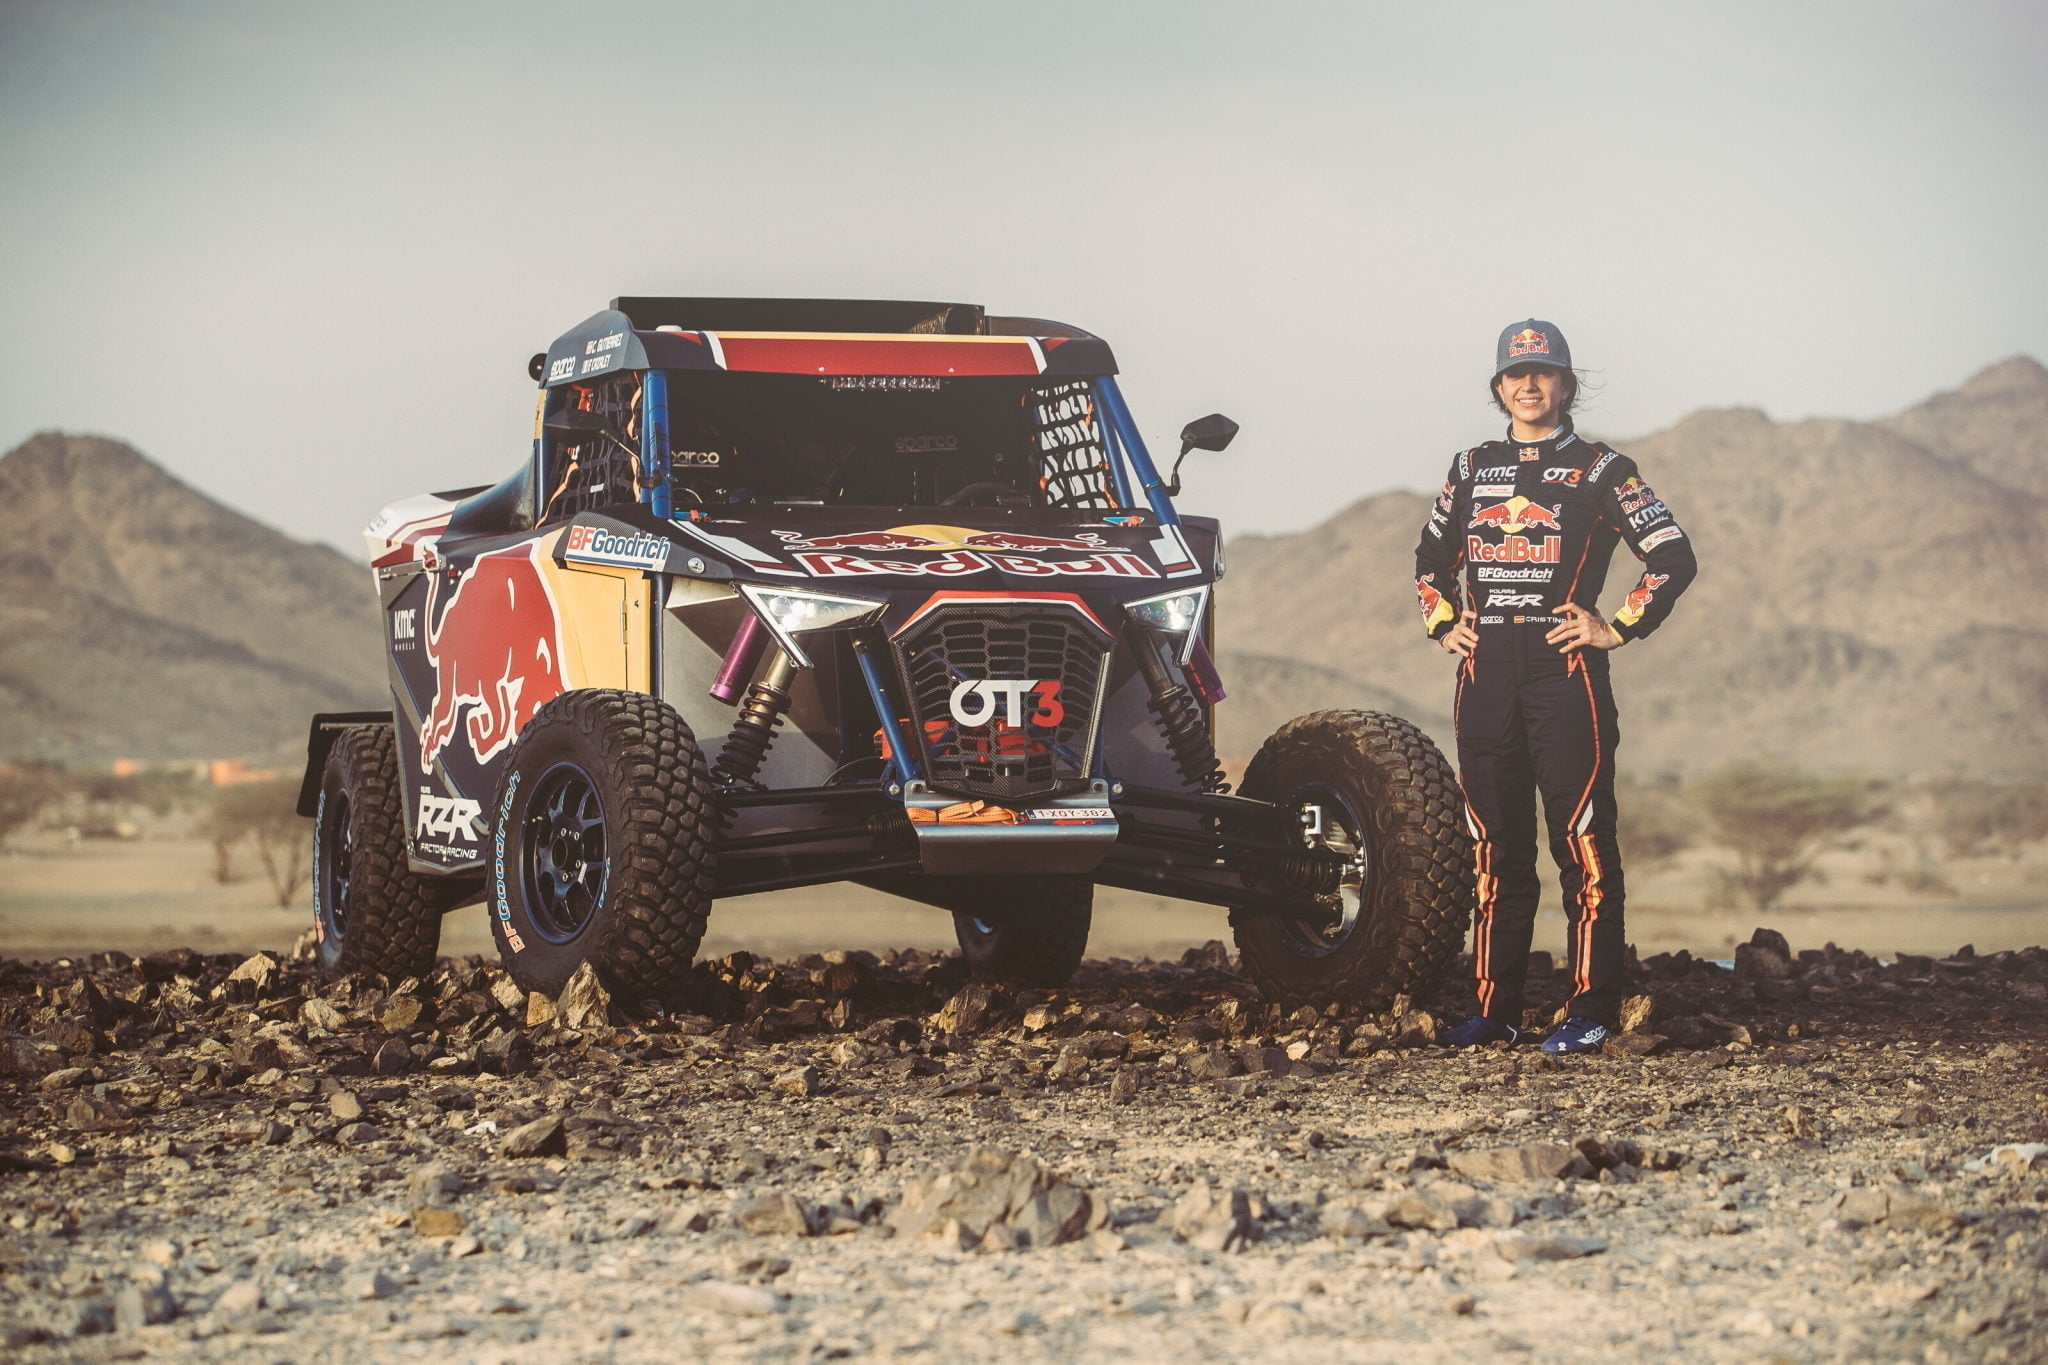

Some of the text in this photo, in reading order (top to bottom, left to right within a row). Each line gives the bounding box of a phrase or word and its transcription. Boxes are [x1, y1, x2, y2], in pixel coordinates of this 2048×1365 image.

[671, 450, 720, 465] arco
[567, 525, 671, 560] BFGoodrich
[1477, 567, 1553, 580] BFGoodrich
[1484, 594, 1544, 609] RZR
[394, 608, 415, 640] KMC
[416, 794, 482, 845] RZR
[446, 846, 478, 859] RACING
[496, 769, 526, 953] BFGoodrich
